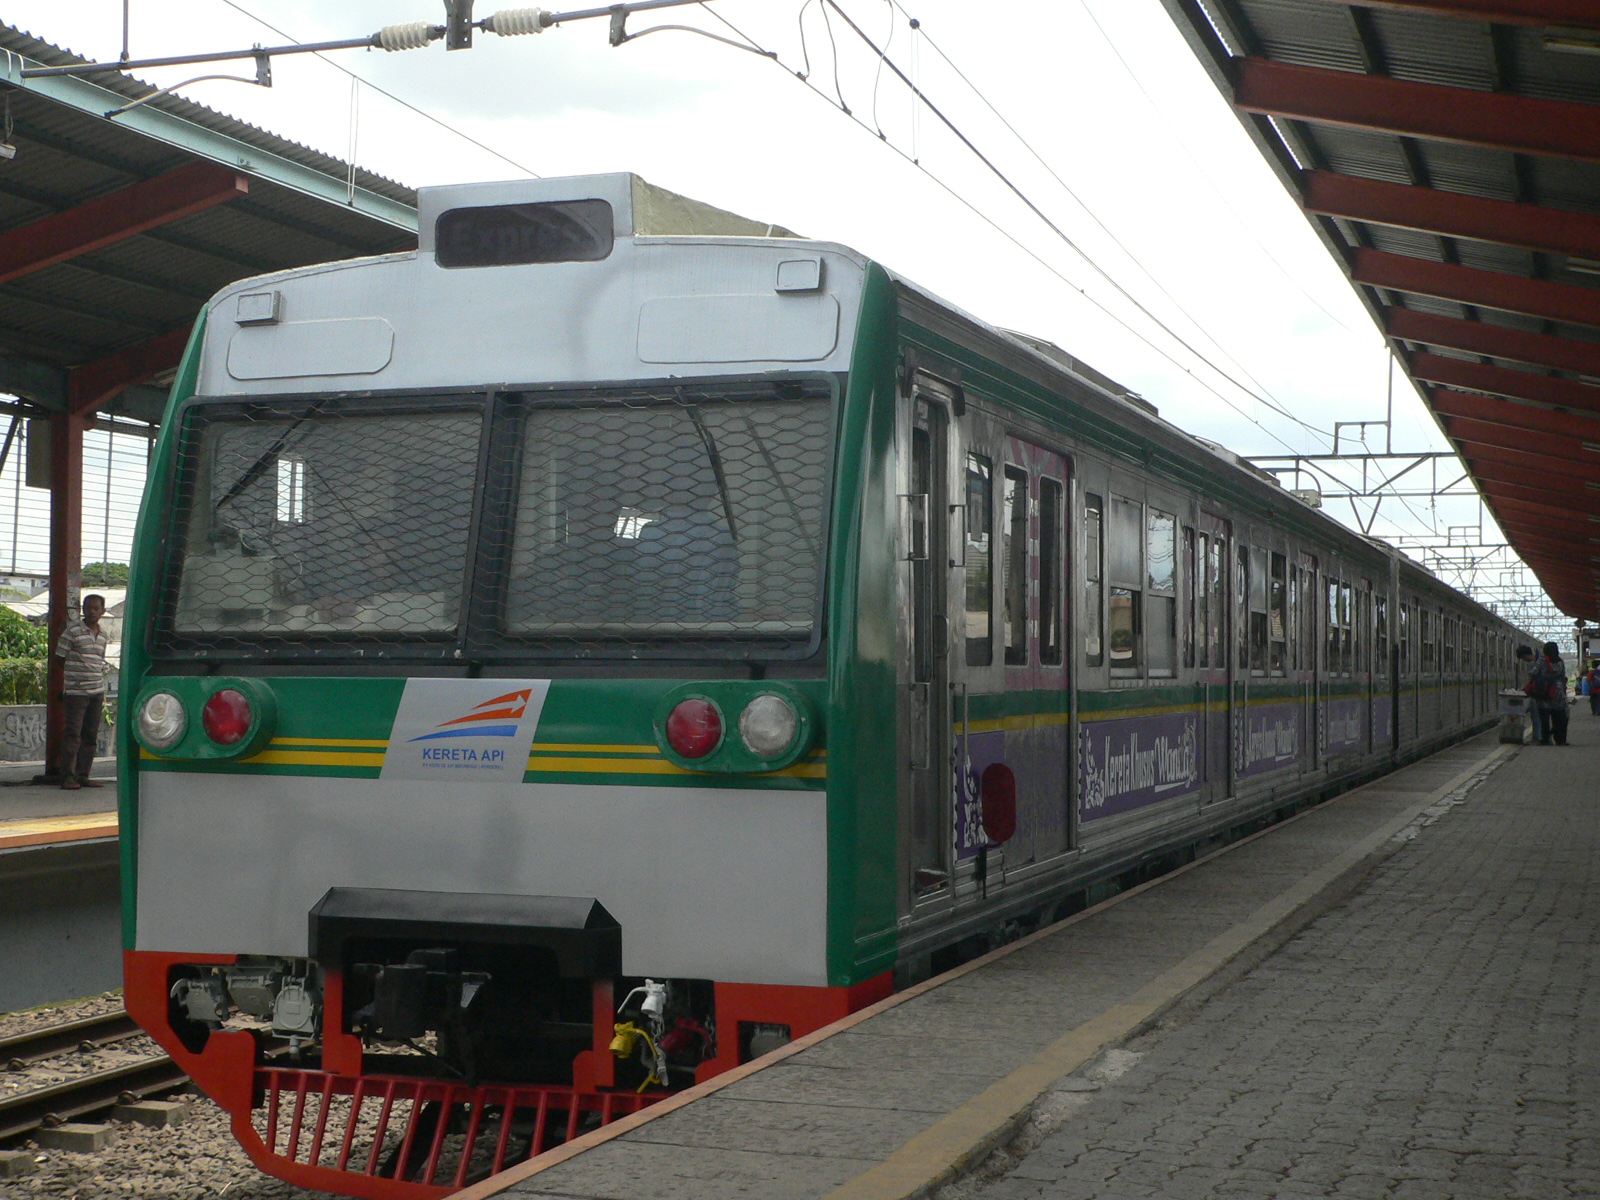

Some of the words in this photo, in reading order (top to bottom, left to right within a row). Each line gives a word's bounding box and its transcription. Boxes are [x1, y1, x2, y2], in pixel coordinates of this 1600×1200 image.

[422, 748, 478, 761] KERETA
[481, 749, 504, 762] API
[1104, 735, 1130, 799] Kereta
